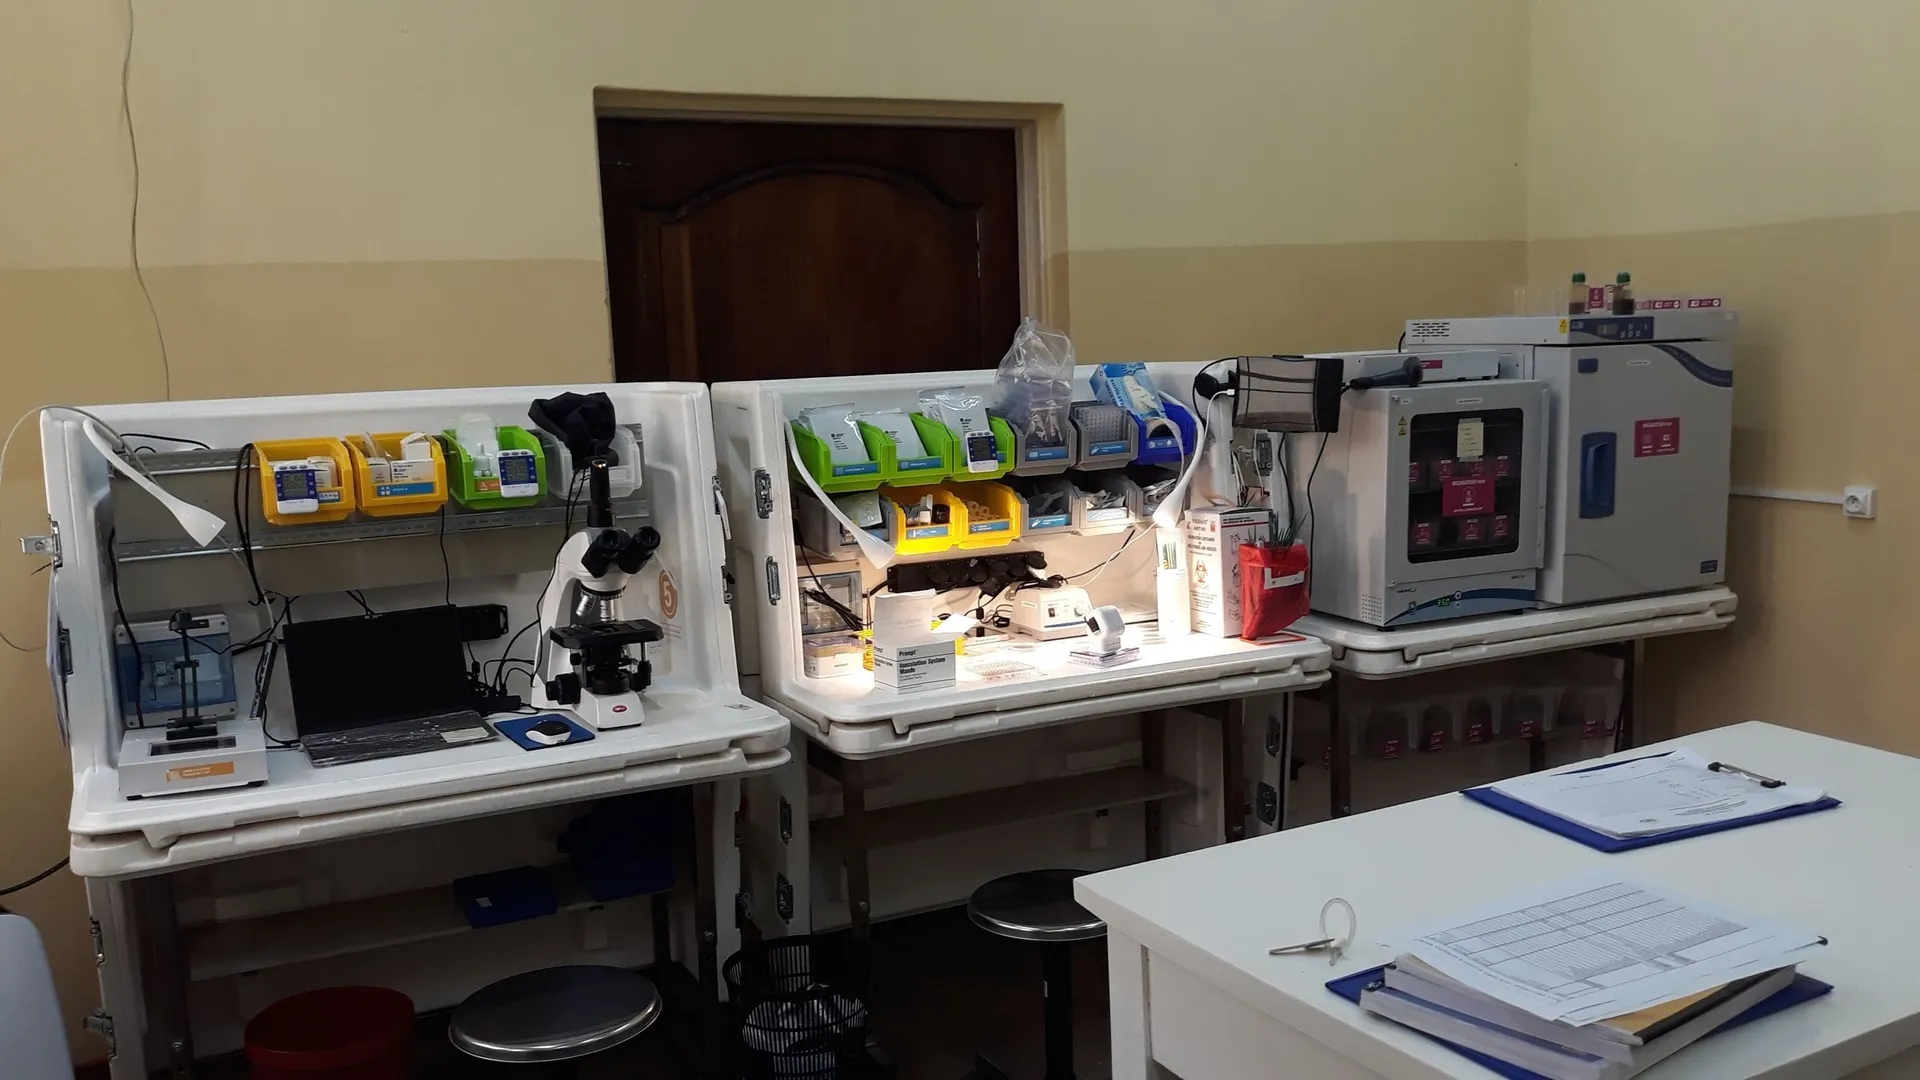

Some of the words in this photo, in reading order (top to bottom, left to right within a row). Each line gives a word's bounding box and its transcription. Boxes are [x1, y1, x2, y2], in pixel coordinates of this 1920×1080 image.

[663, 580, 672, 607] 5
[899, 649, 917, 657] Prompt
[899, 660, 927, 668] Inoculation
[928, 657, 946, 665] System
